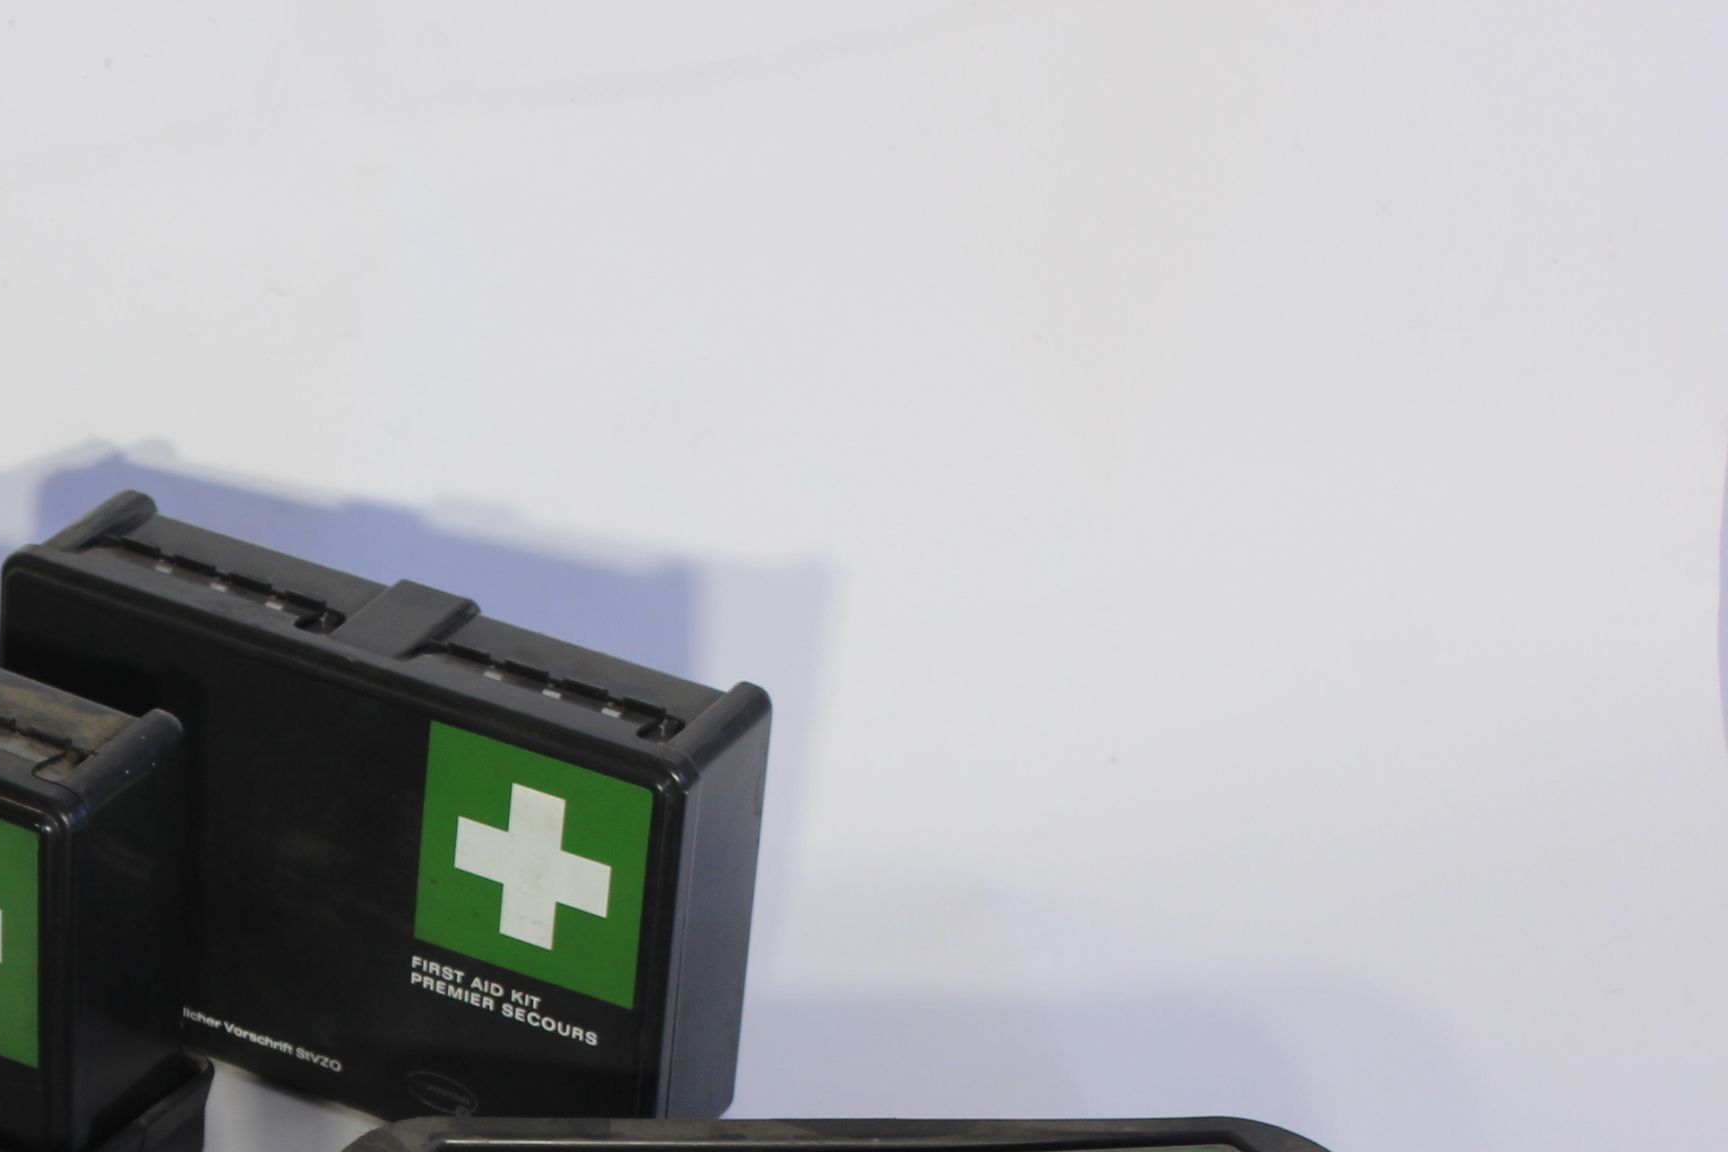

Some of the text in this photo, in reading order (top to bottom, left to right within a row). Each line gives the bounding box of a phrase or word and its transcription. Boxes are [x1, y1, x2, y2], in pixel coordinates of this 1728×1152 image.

[410, 955, 542, 1010] FIRST AID KIT
[410, 971, 599, 1046] PREMIER SECOURS
[223, 1021, 294, 1055] Vorschrift
[295, 1047, 343, 1073] StVZO
